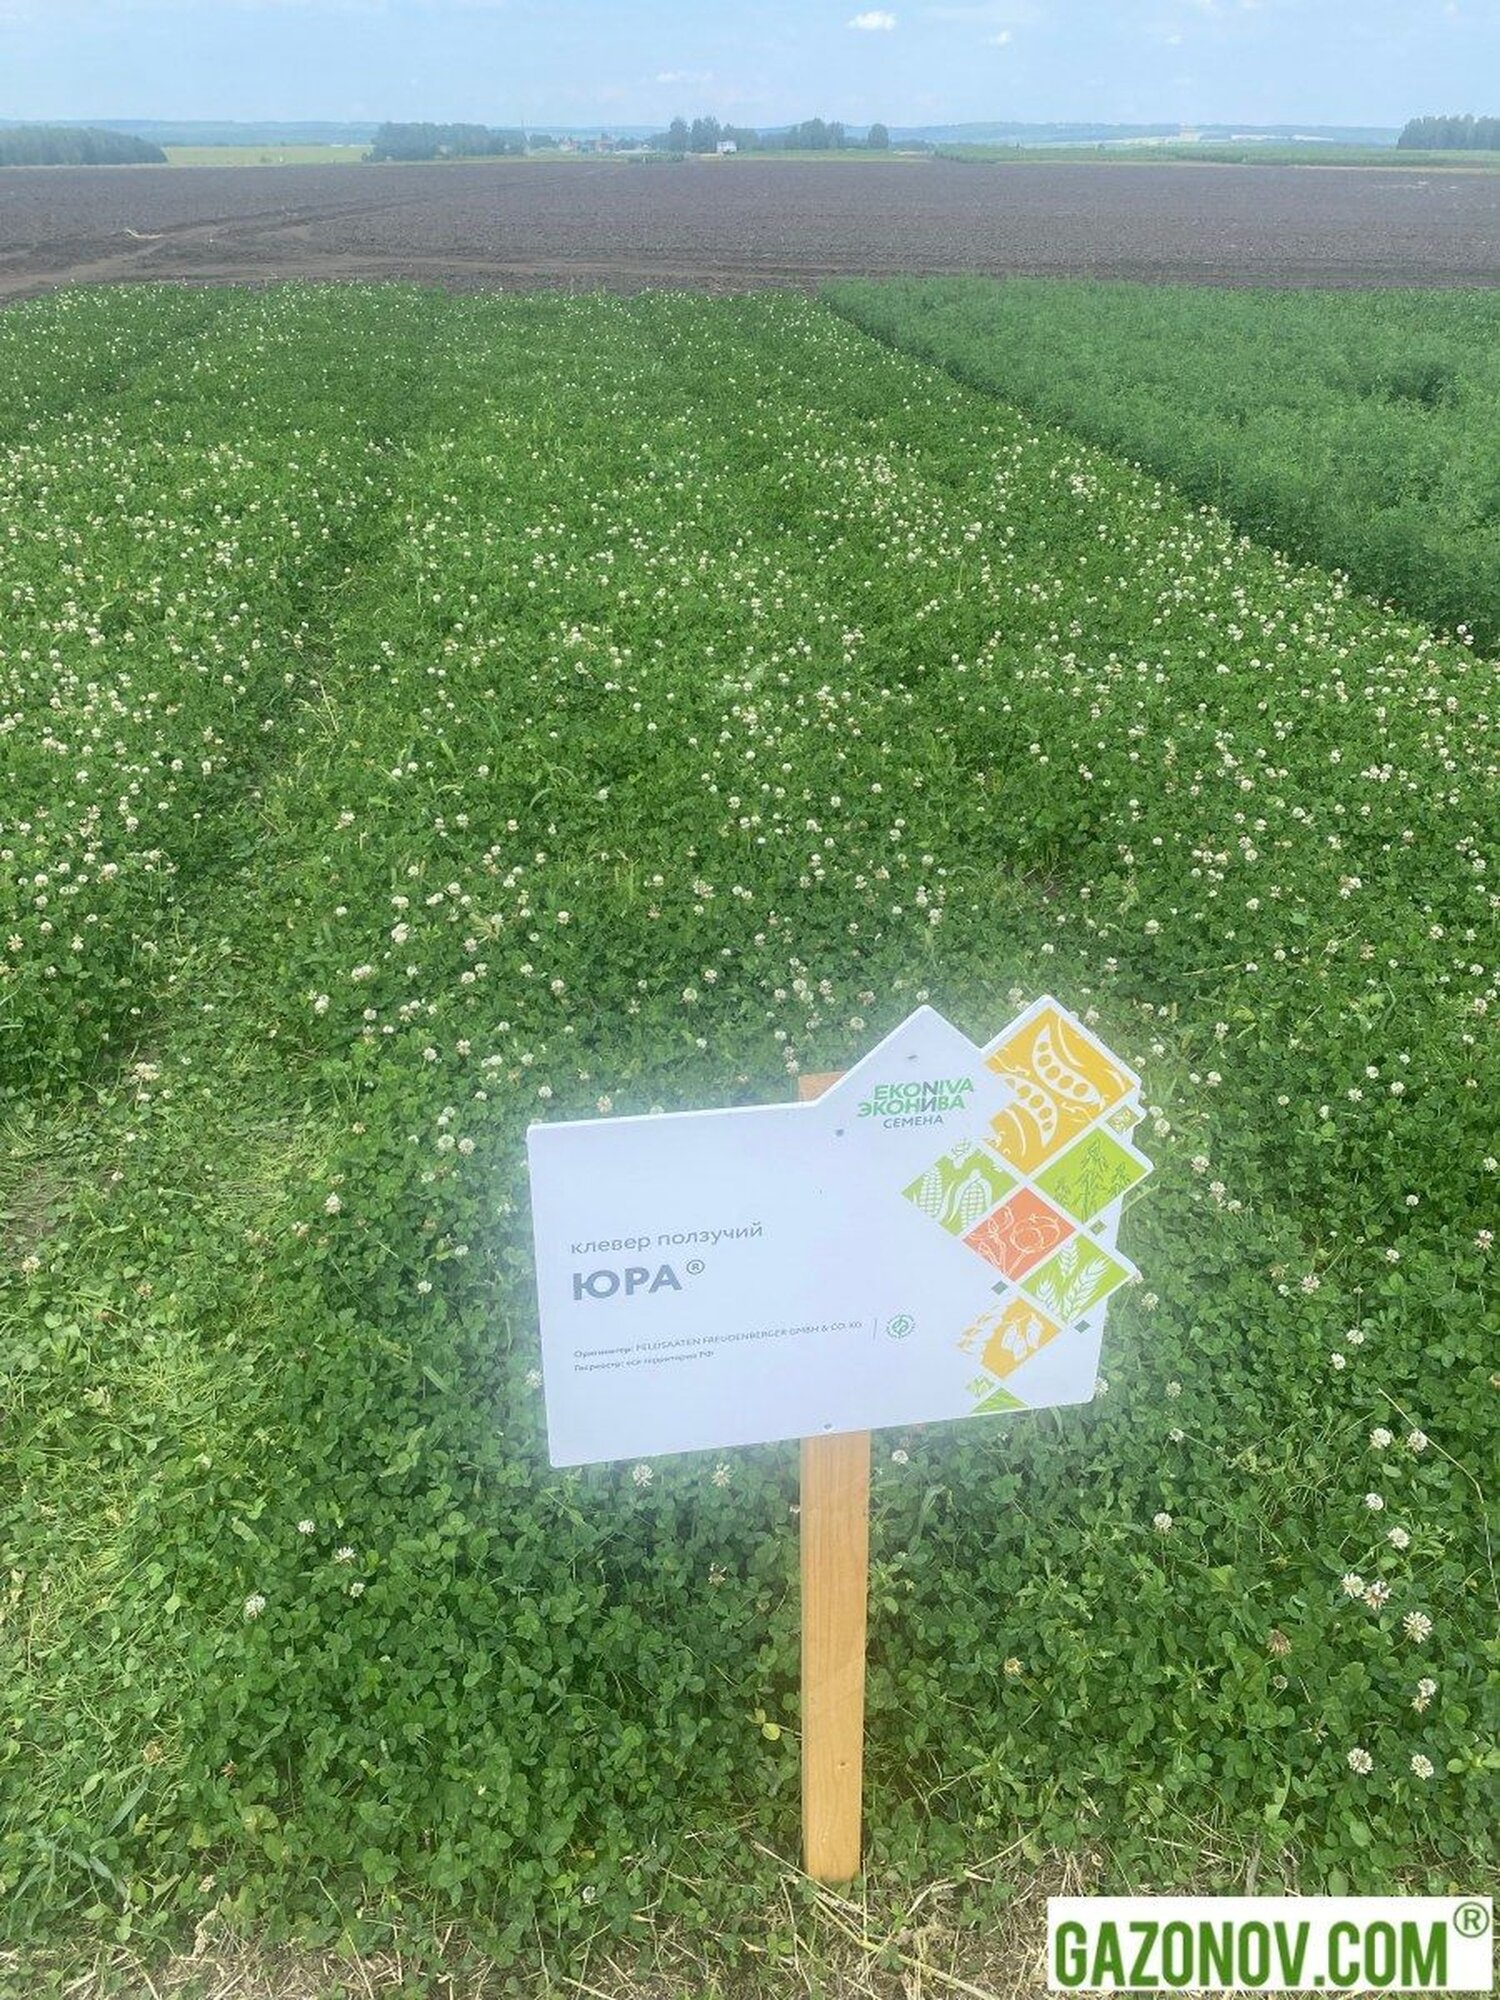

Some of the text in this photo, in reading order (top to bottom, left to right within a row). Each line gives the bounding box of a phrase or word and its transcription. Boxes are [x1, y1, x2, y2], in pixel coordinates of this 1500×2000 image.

[874, 1077, 974, 1100] EKONIVA
[857, 1094, 966, 1117] ЭКОНИВА
[883, 1115, 944, 1129] СЕМЕНА
[571, 1220, 763, 1253] клевер ползучий
